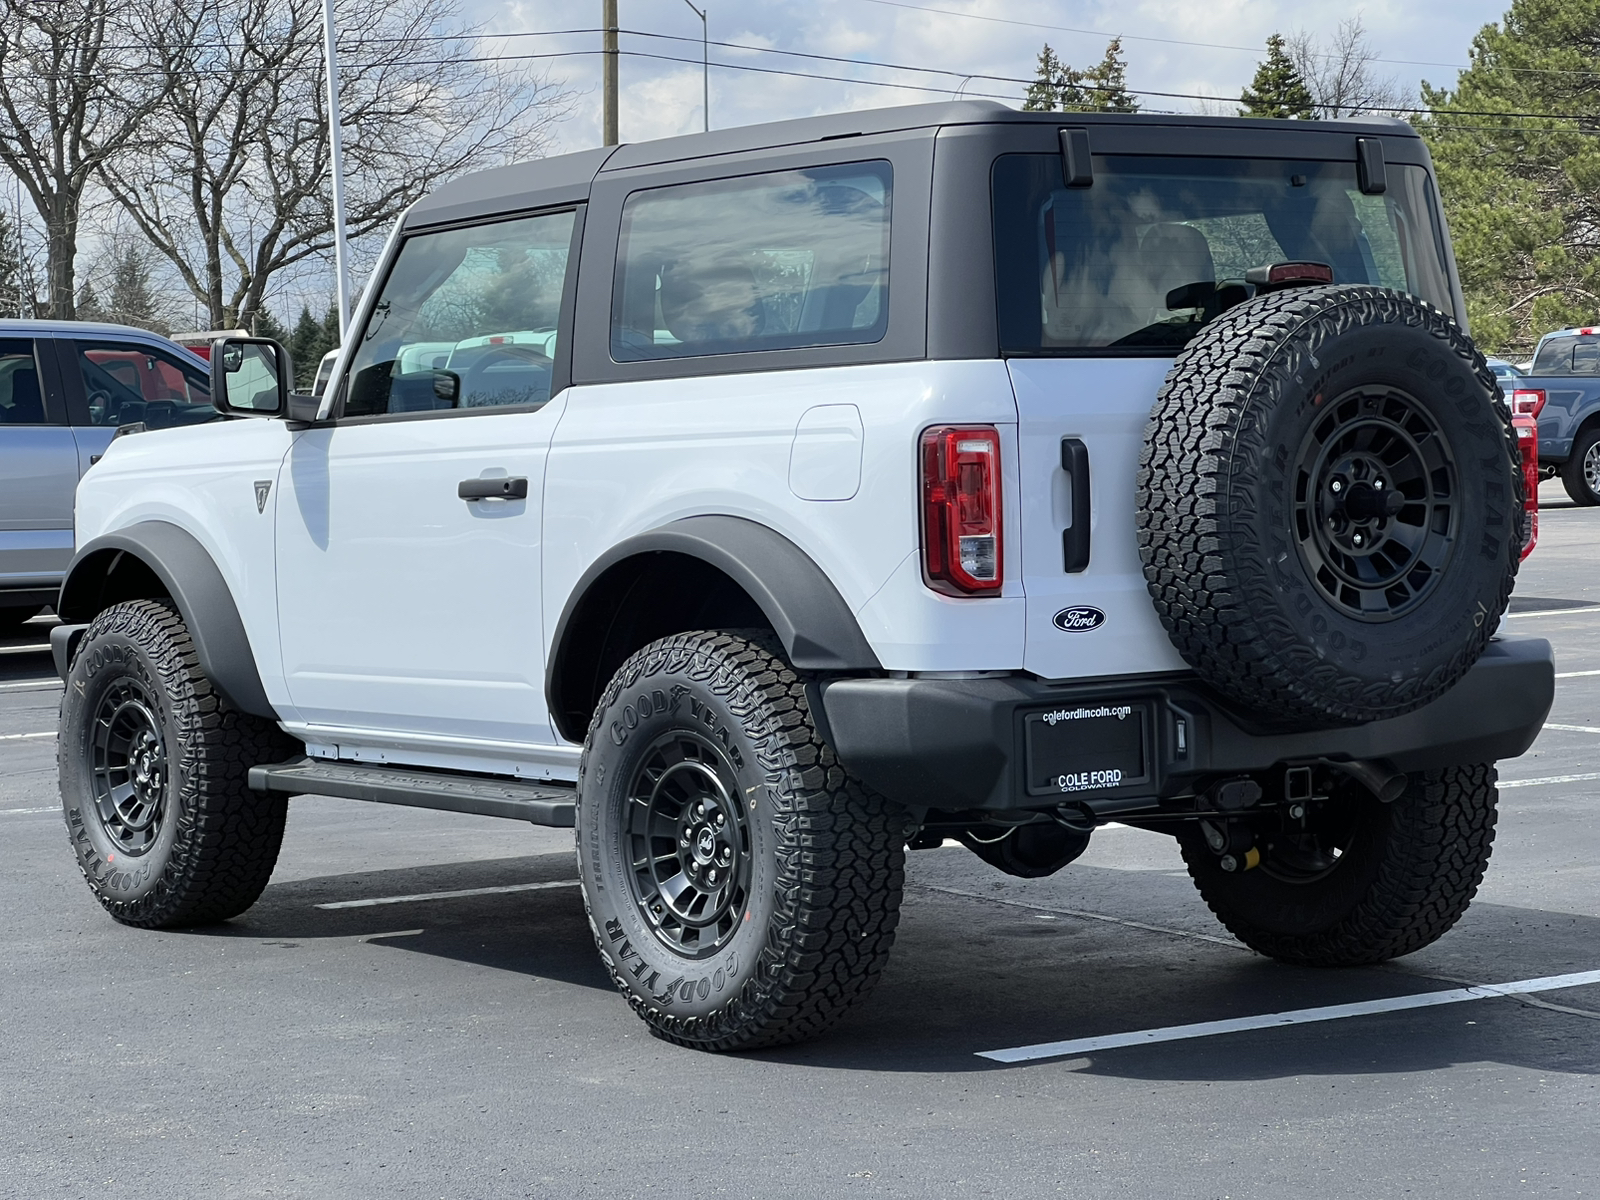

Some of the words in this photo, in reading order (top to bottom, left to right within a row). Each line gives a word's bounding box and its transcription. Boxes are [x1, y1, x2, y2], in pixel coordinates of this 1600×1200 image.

[1064, 609, 1096, 628] Ford
[1042, 705, 1131, 722] colefordlincoln.com
[1058, 772, 1089, 787] COLE
[1091, 769, 1121, 784] FORD
[1061, 782, 1120, 792] COLDWATER
